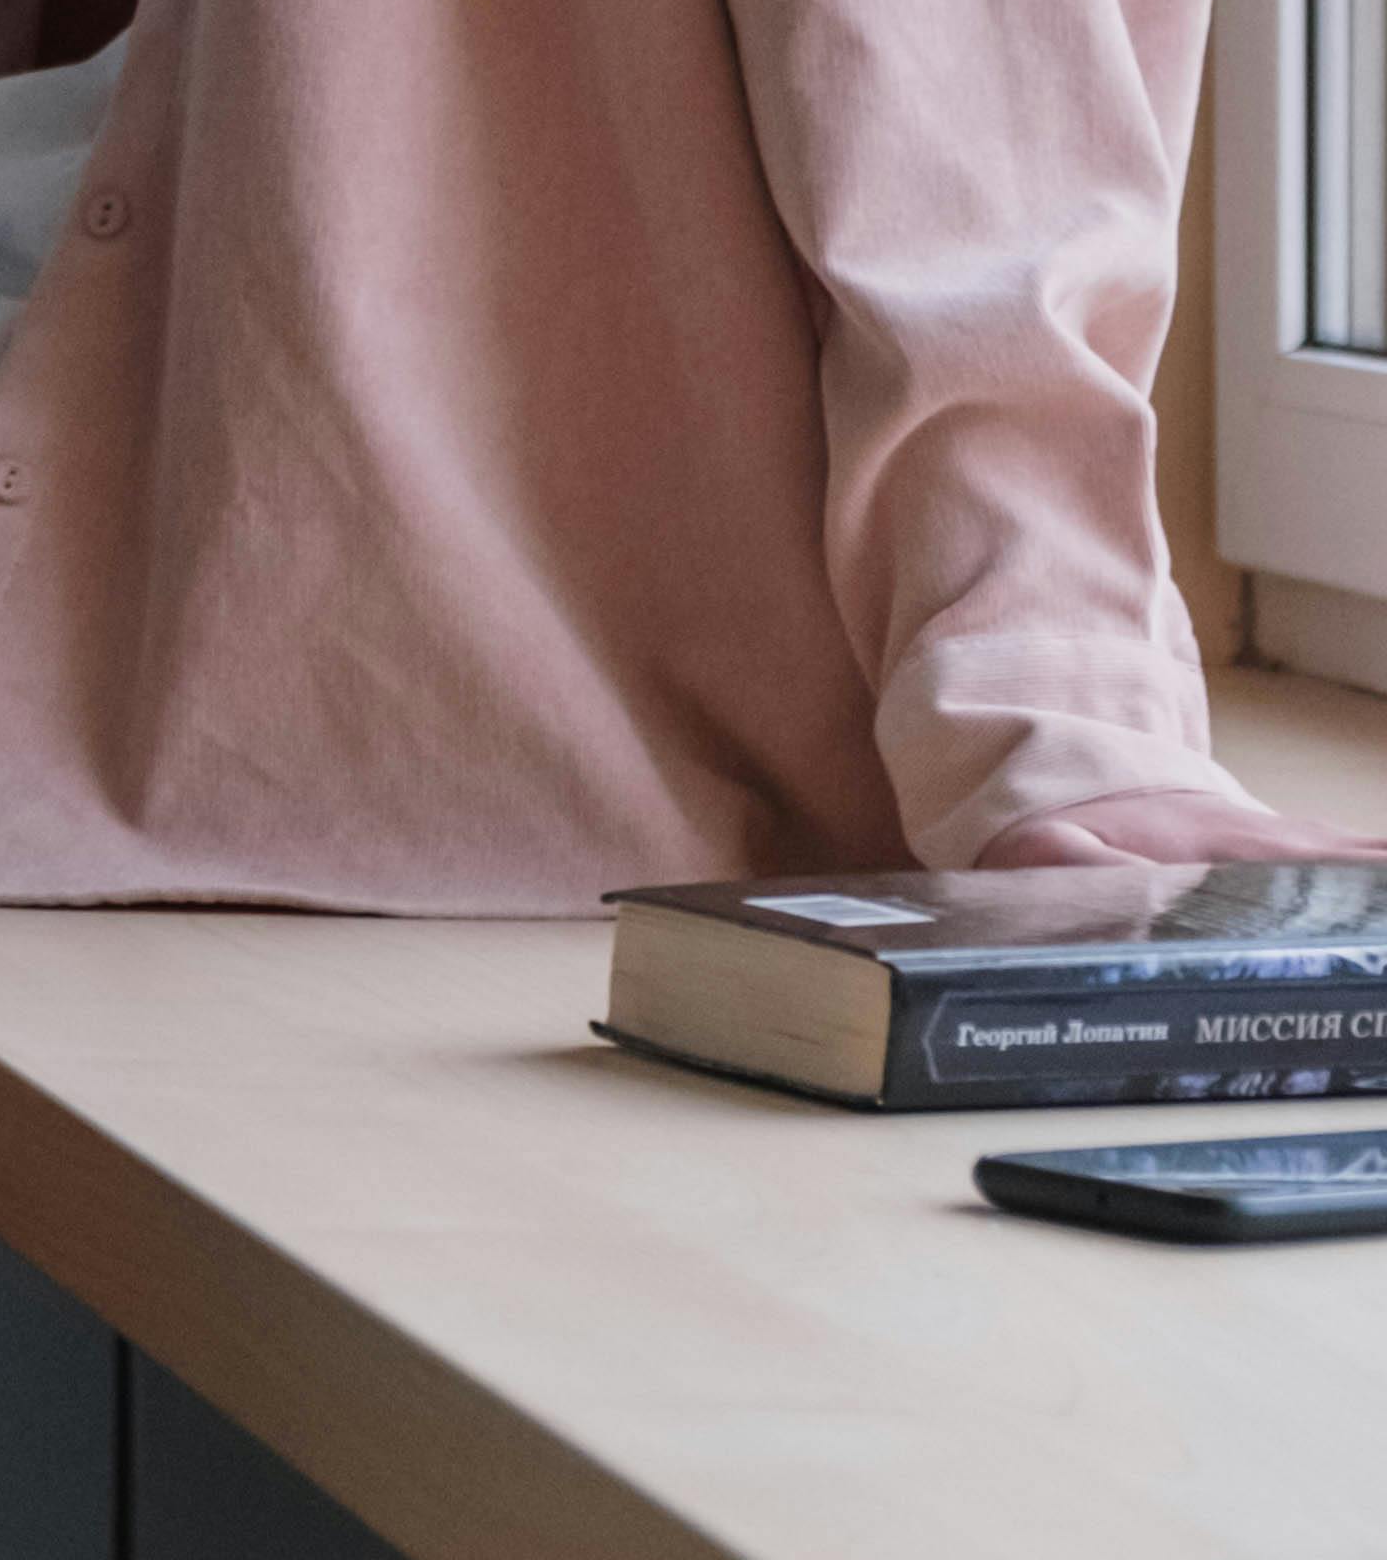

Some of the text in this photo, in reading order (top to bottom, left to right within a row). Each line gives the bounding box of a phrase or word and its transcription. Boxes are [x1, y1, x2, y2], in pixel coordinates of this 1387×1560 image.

[956, 1018, 1169, 1052] Георгий Лопатин
[1196, 1012, 1345, 1044] МИССИЯ
